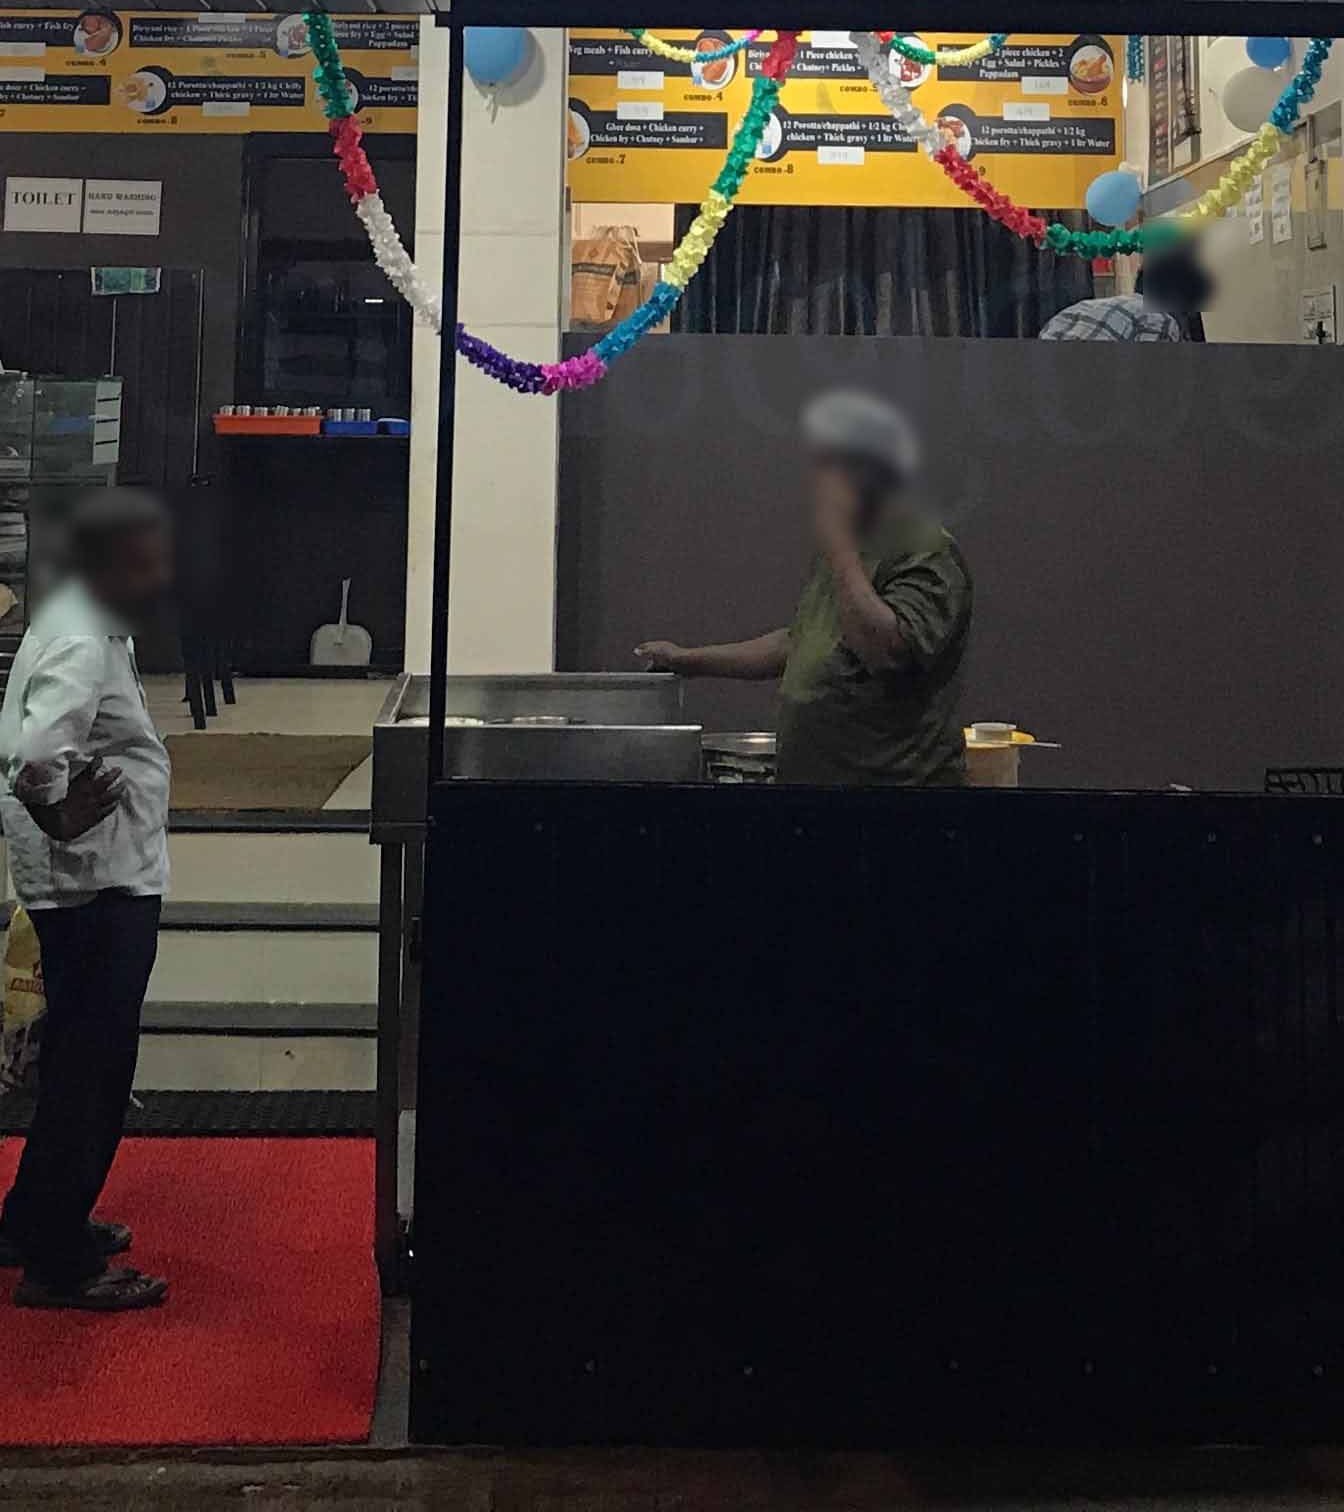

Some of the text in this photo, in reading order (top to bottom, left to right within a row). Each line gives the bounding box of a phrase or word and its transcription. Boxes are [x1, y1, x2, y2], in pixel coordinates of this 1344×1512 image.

[615, 45, 631, 56] Fish
[649, 123, 677, 134] Chicken
[786, 132, 815, 143] chicken
[824, 132, 844, 143] Thick
[846, 132, 868, 143] gravy
[1019, 137, 1040, 148] Thick
[10, 191, 77, 206] TOILET
